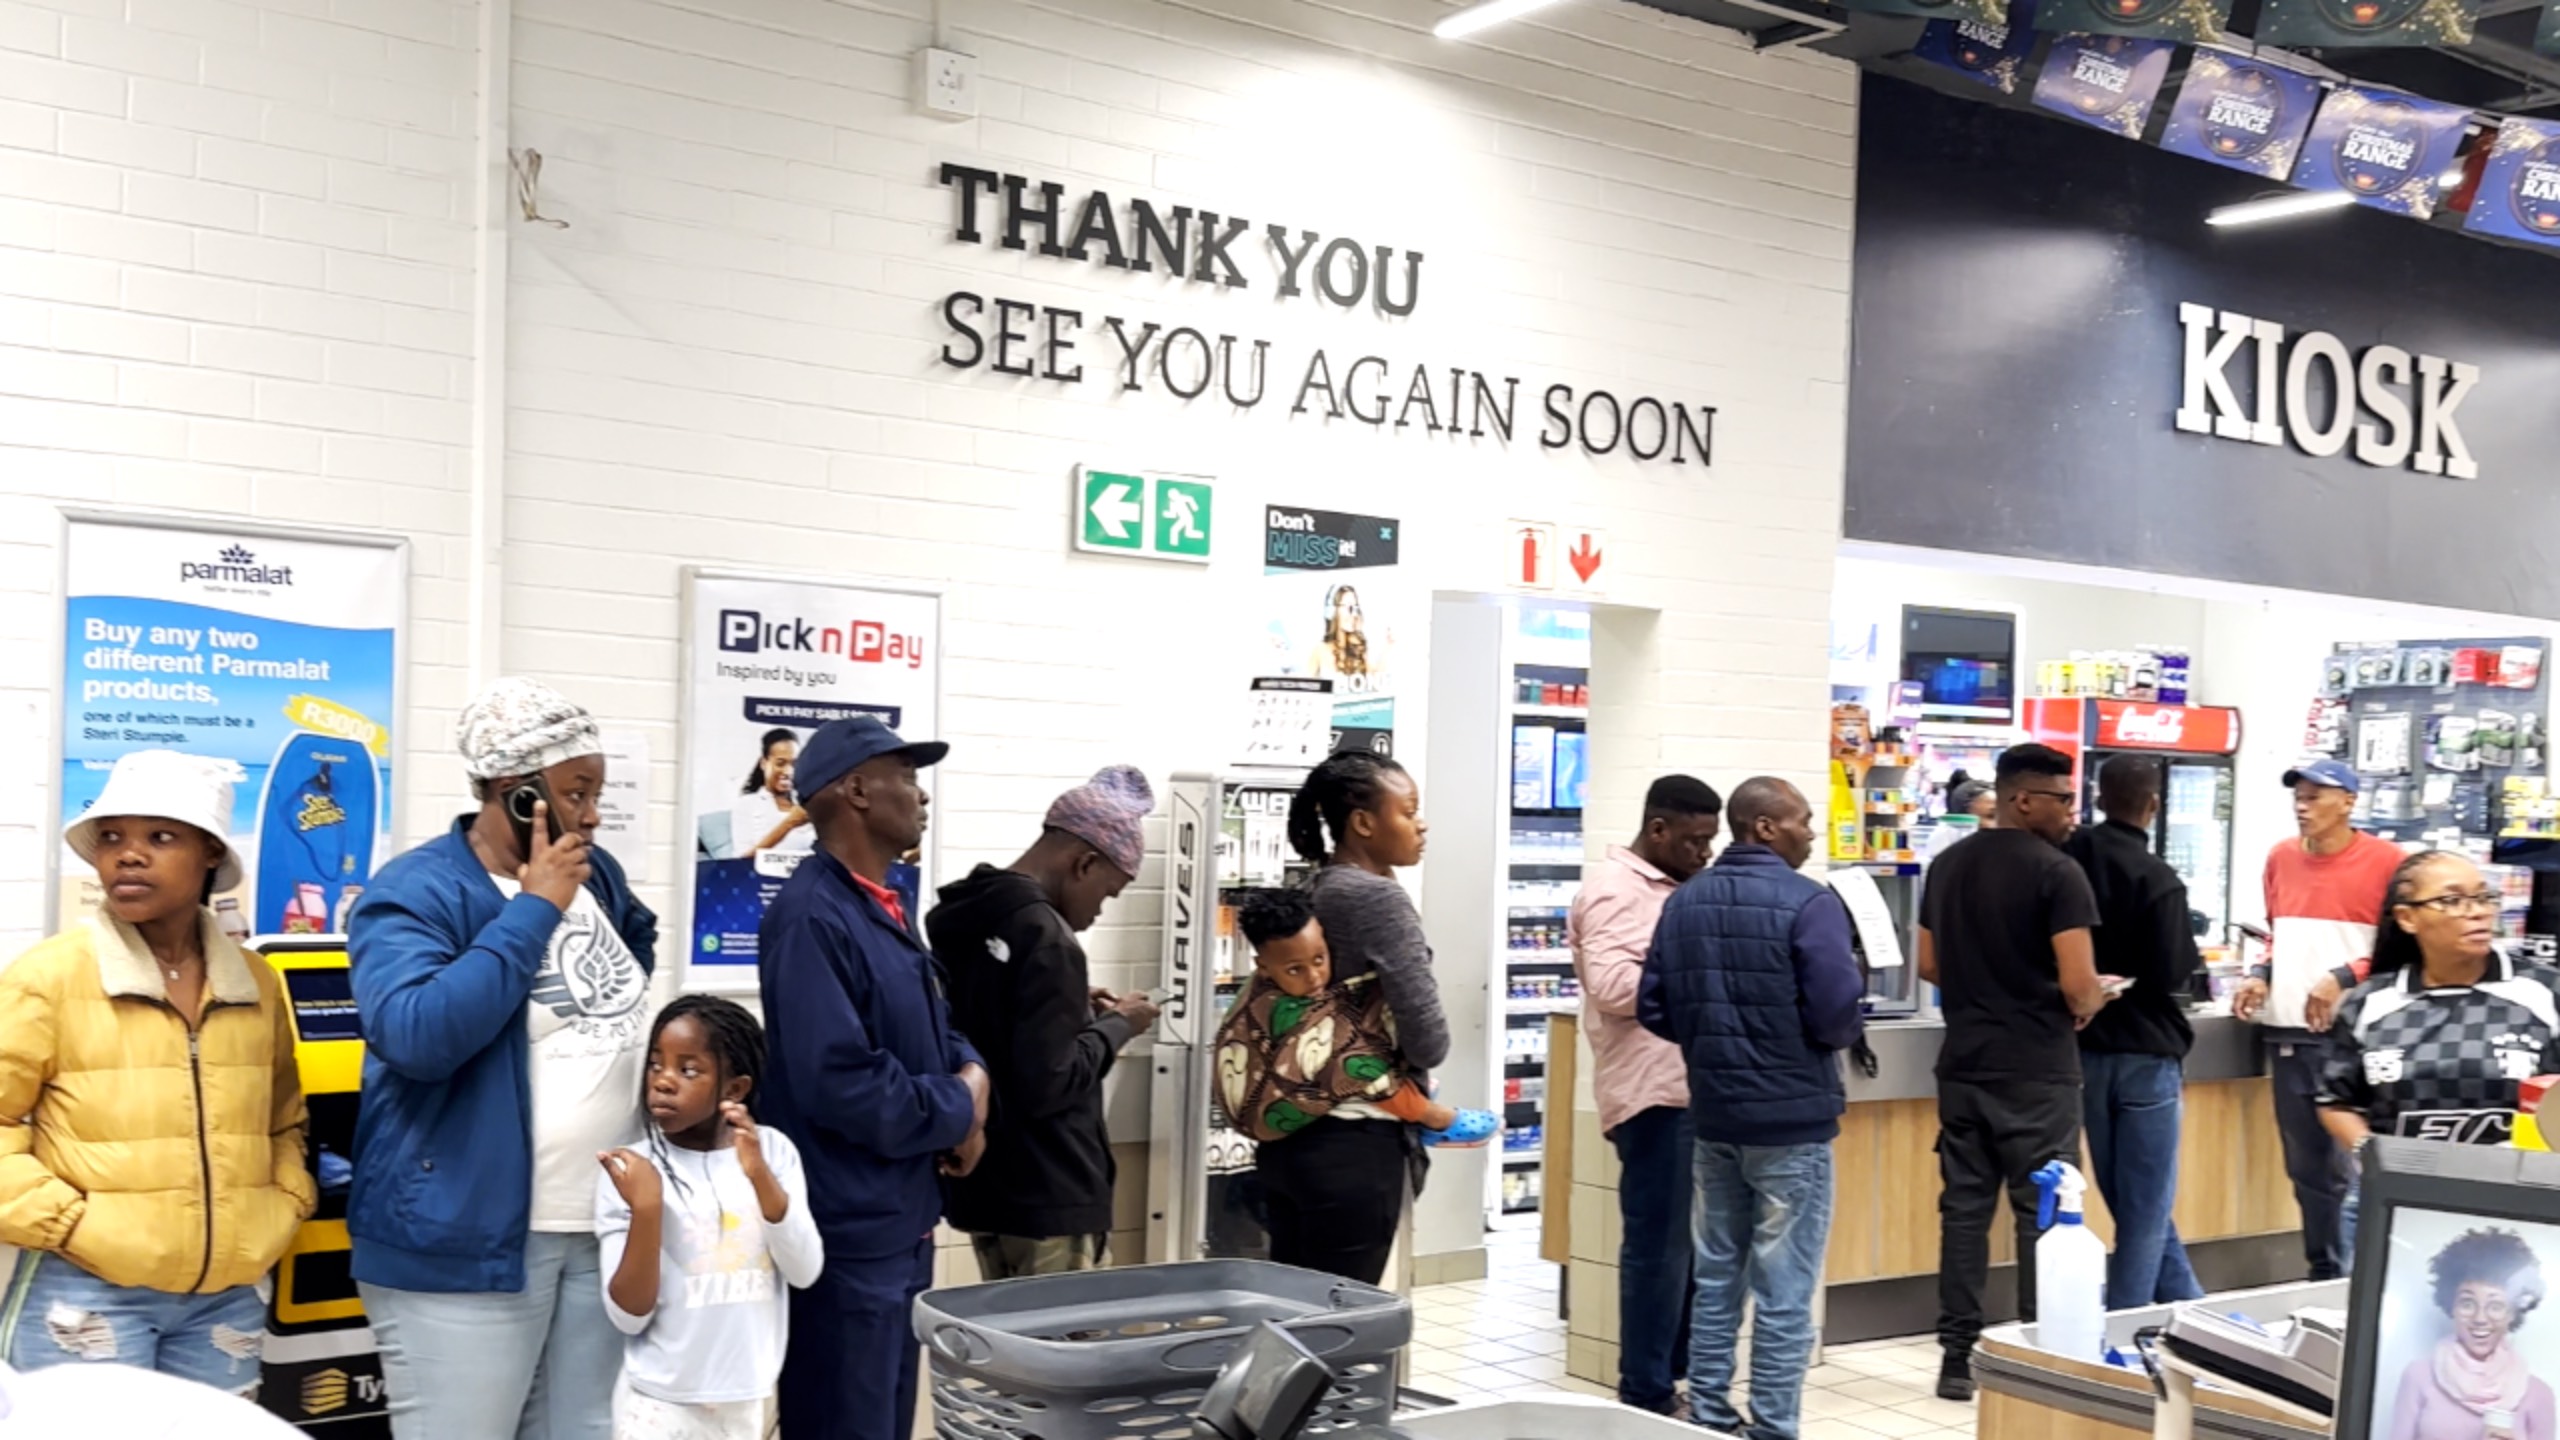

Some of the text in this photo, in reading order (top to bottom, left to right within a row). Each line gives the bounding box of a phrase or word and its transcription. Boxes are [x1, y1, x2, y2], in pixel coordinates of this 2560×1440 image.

[1956, 20, 2009, 49] RANGE
[2073, 65, 2127, 93] RANGE
[2207, 106, 2270, 134] RANGE
[2342, 141, 2411, 171] RANGE
[940, 162, 1424, 317] THANK YOU
[941, 290, 1718, 467] SEE YOU AGAIN SOON
[2176, 301, 2480, 480] KIOSK
[1268, 510, 1315, 531] Don't
[1267, 531, 1340, 566] MISS
[180, 561, 294, 587] parmalat
[84, 617, 259, 652] Buy any two
[820, 627, 843, 655] n
[849, 620, 923, 669] Pay
[83, 648, 331, 681] different Parmalat
[716, 661, 837, 687] Inspired by you
[83, 677, 220, 706] products,
[83, 711, 255, 728] one of which must be a
[83, 727, 190, 744] Steri Stumpie.
[1171, 821, 1195, 1020] WAVES
[352, 1374, 385, 1403] Ty
